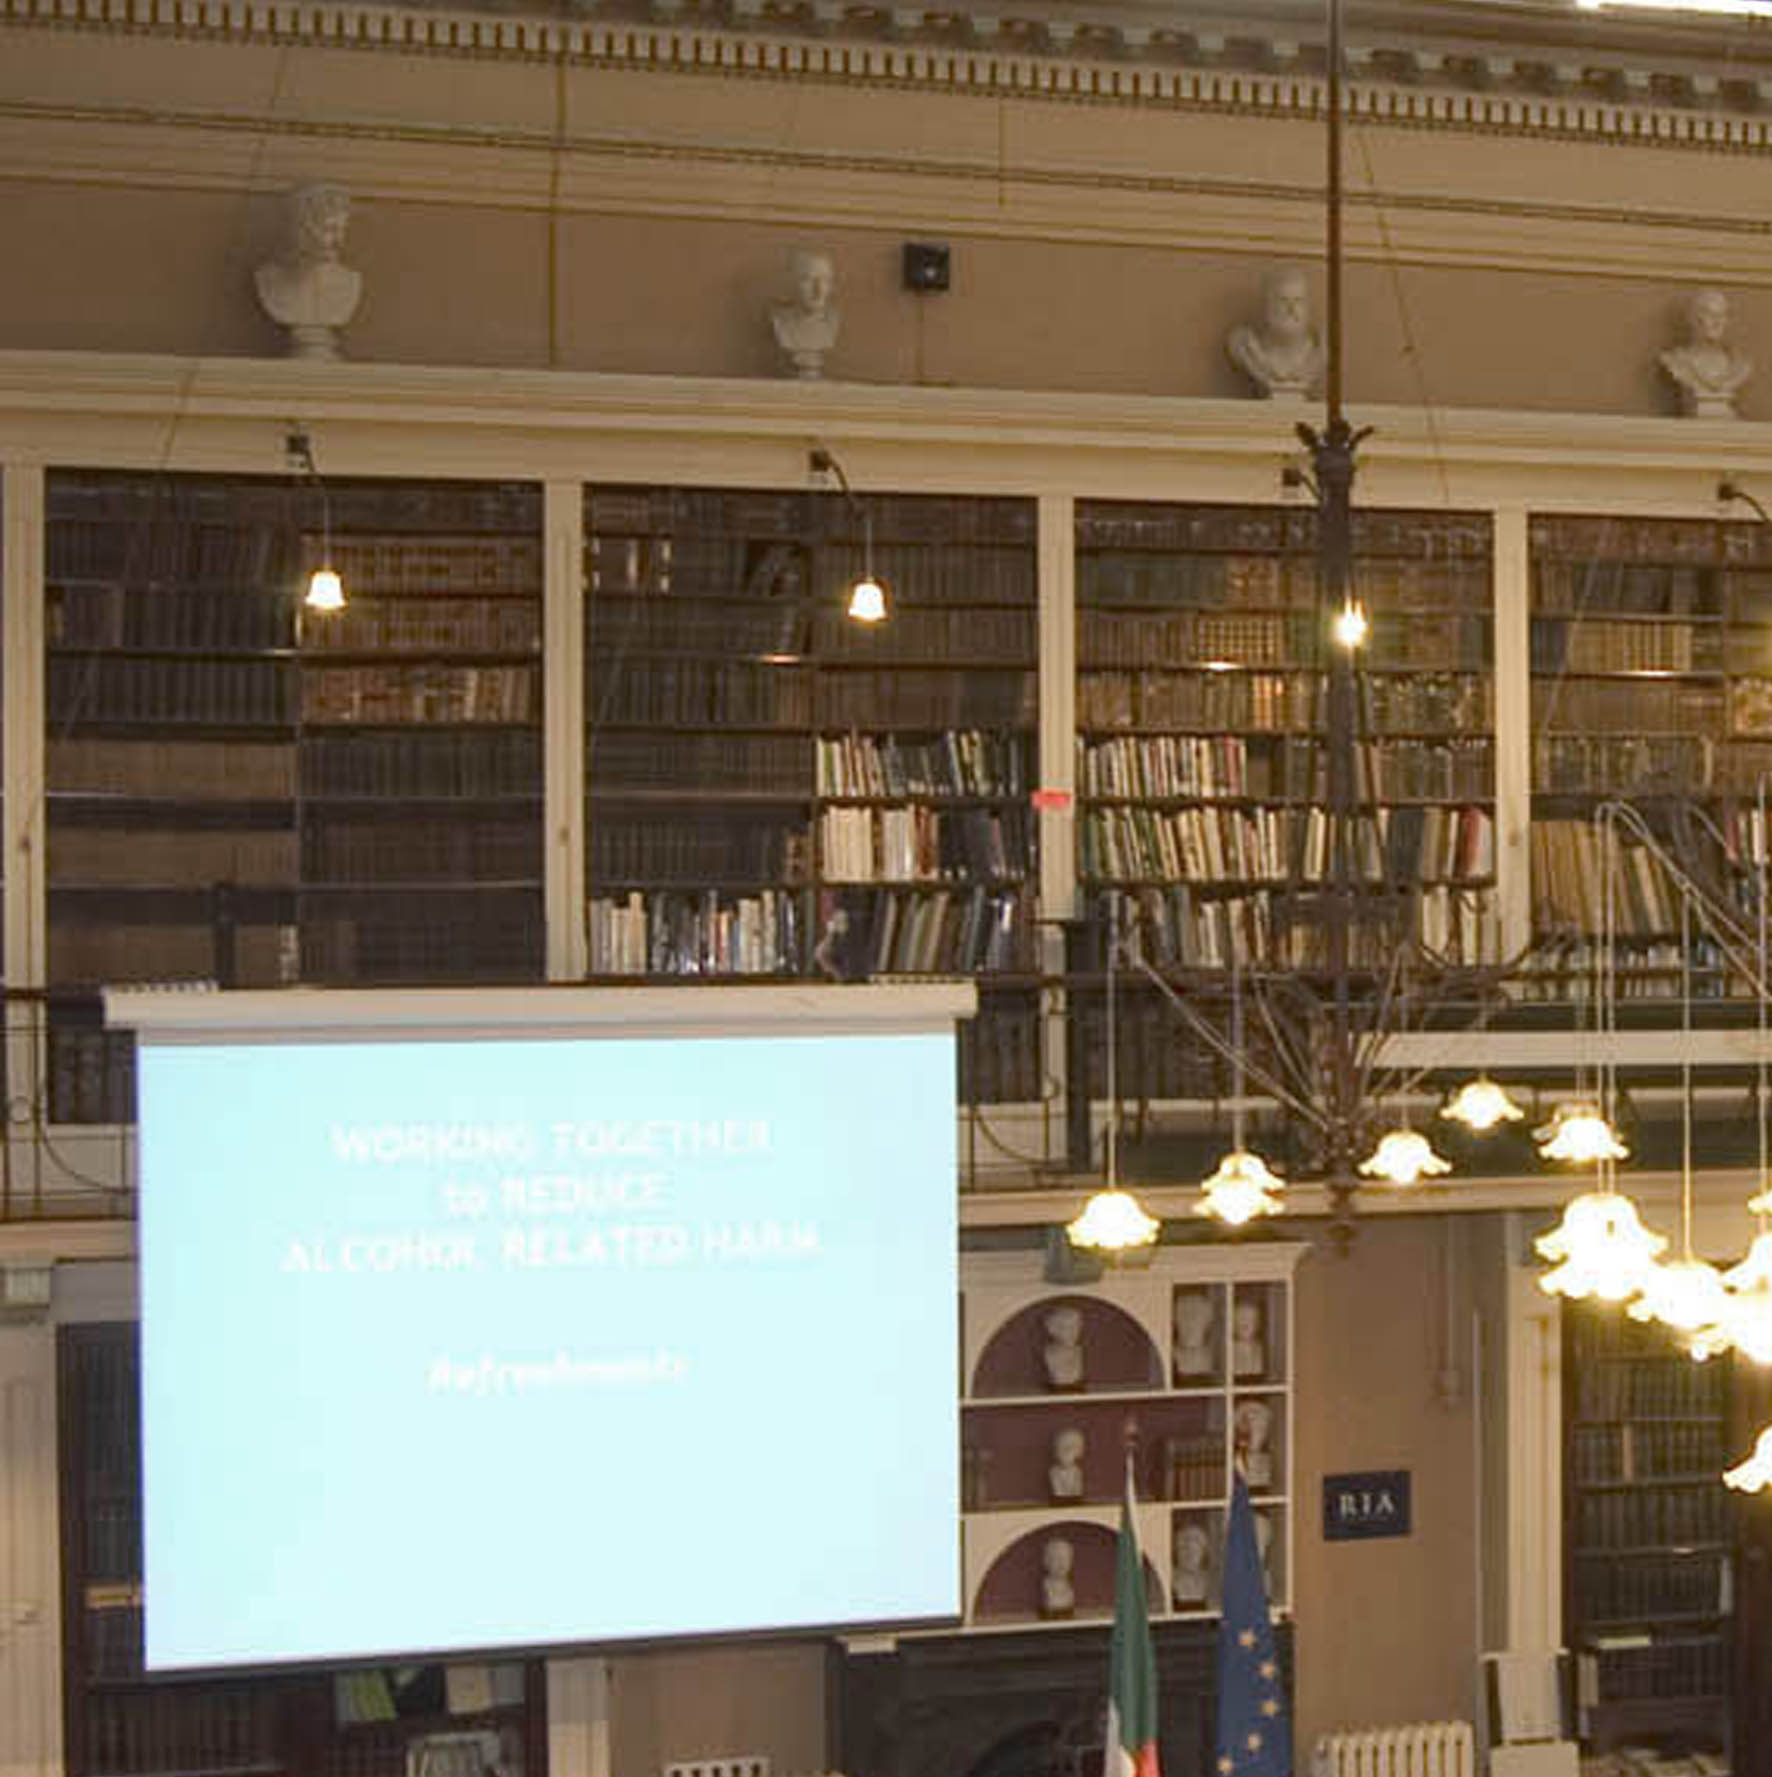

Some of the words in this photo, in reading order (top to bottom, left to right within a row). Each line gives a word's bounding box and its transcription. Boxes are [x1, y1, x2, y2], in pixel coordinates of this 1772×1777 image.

[332, 1121, 531, 1166] WORKING
[550, 1120, 774, 1160] TOGETHER
[501, 1175, 670, 1216] REDUCE
[280, 1234, 484, 1273] ALCOHOL
[502, 1225, 689, 1269] RELATED
[704, 1219, 822, 1264] HARM
[1338, 1490, 1397, 1520] RIA
